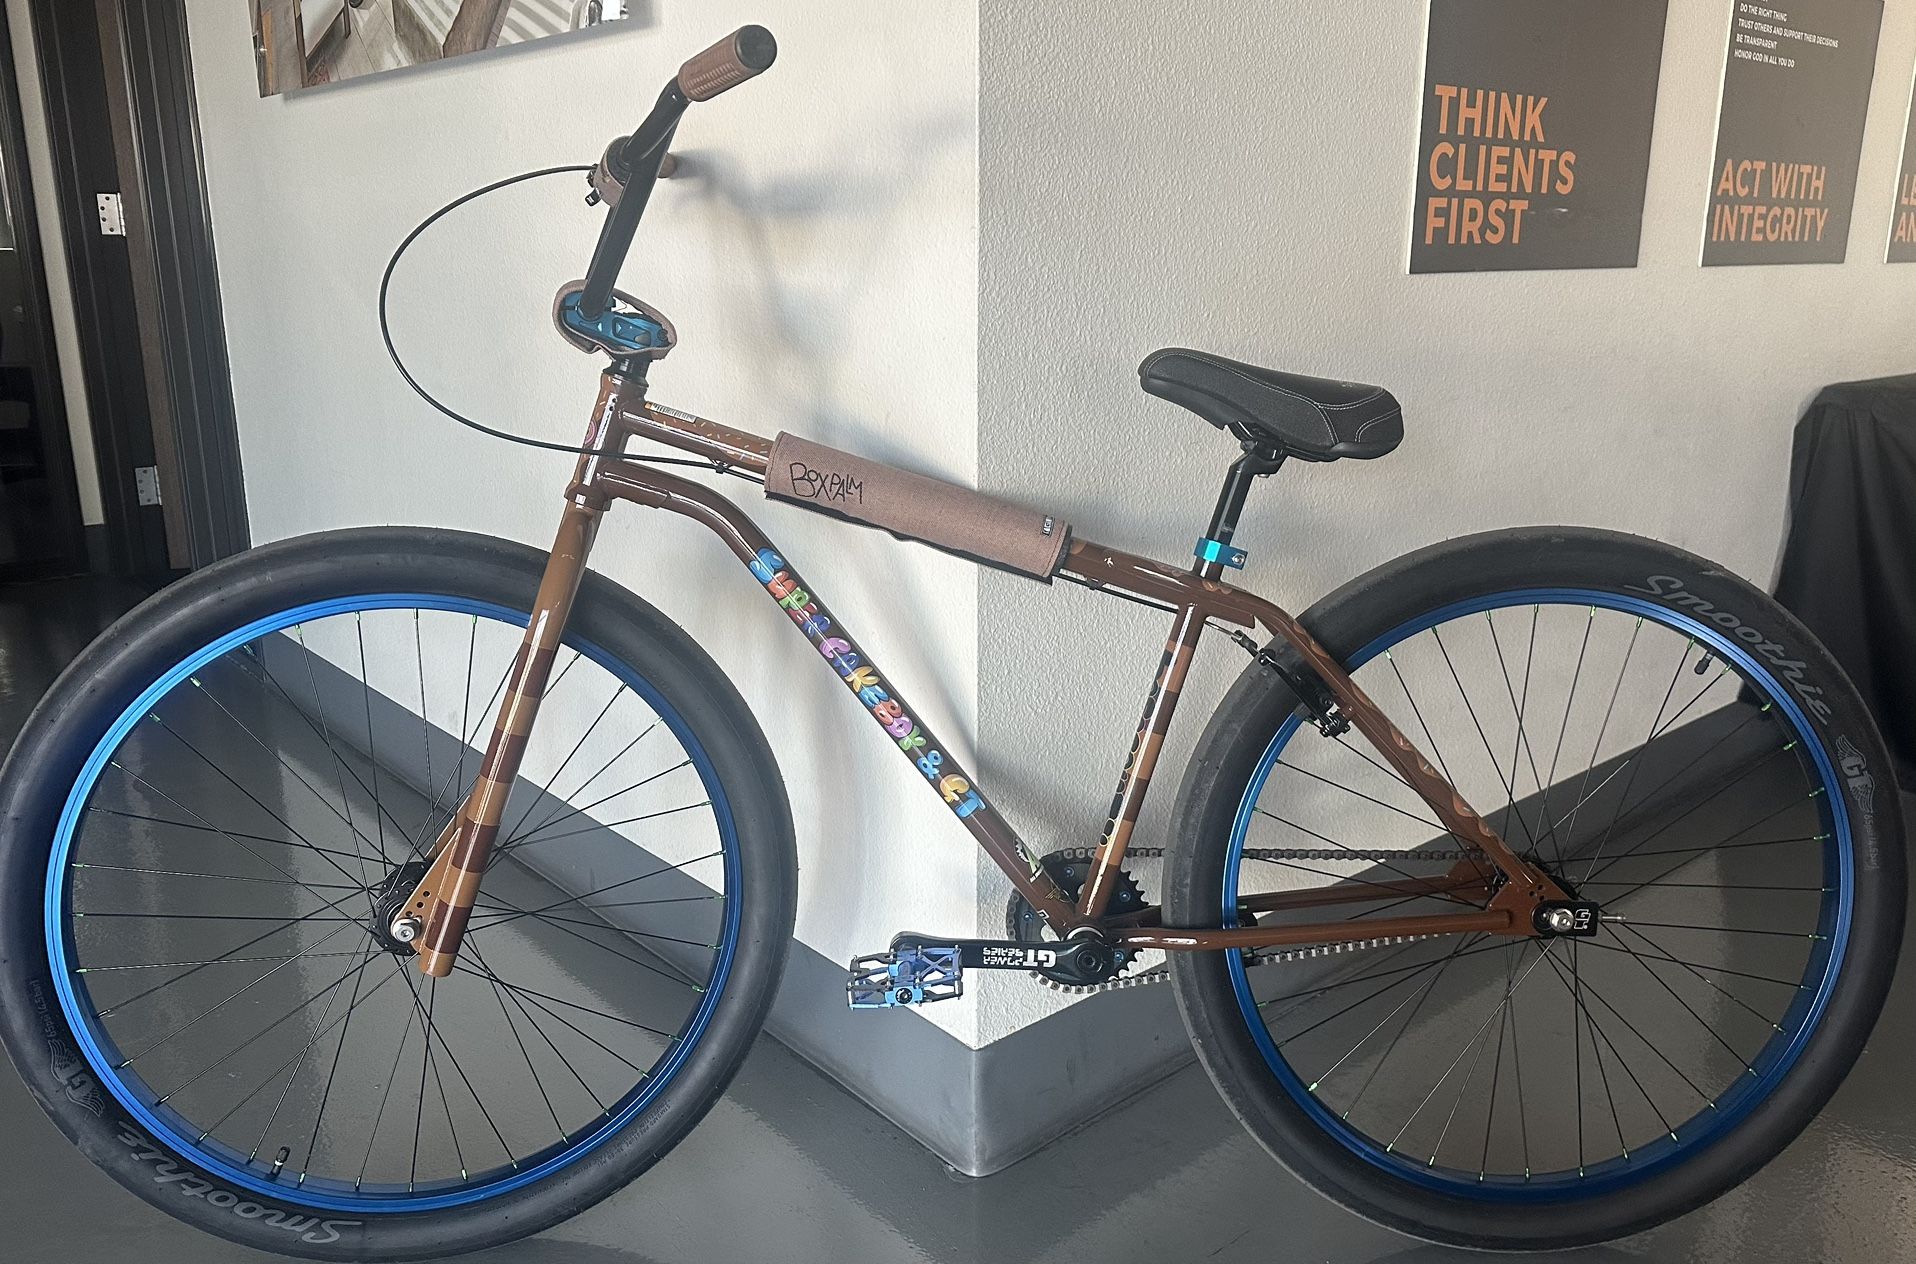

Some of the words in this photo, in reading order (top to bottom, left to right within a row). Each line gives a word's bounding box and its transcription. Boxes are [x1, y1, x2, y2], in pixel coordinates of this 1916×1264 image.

[1740, 3, 1748, 12] DO
[1749, 5, 1758, 15] THE
[1758, 7, 1773, 18] RIGHT
[1773, 11, 1787, 22] THING
[1736, 33, 1743, 43] BE
[1744, 35, 1777, 49] TRANSPARENT
[1738, 18, 1754, 29] TRUST
[1754, 21, 1773, 33] OTHERS
[1773, 26, 1783, 36] AND
[1783, 28, 1804, 40] SUPPORT
[1804, 32, 1816, 43] THEIR
[1816, 36, 1839, 48] DECISIONS
[1734, 49, 1752, 60] HONOR
[1752, 52, 1763, 62] GOD
[1769, 56, 1777, 65] ALL
[1778, 57, 1788, 66] YOU
[1788, 59, 1795, 68] DO
[1435, 84, 1548, 143] THINK
[1430, 141, 1576, 195] CLIENTS
[1717, 158, 1767, 198] ACT
[1769, 162, 1827, 201] WITH
[1424, 197, 1530, 245] FIRST
[1712, 204, 1829, 242] INTEGRITY
[1624, 575, 1832, 726] Smoothie
[749, 547, 831, 638] SUPER
[917, 750, 943, 779] &
[939, 774, 986, 817] GT
[983, 947, 1023, 956] SERIES
[983, 956, 1023, 966] POWER
[1023, 949, 1056, 967] GT
[117, 1120, 364, 1244] Smoothie
